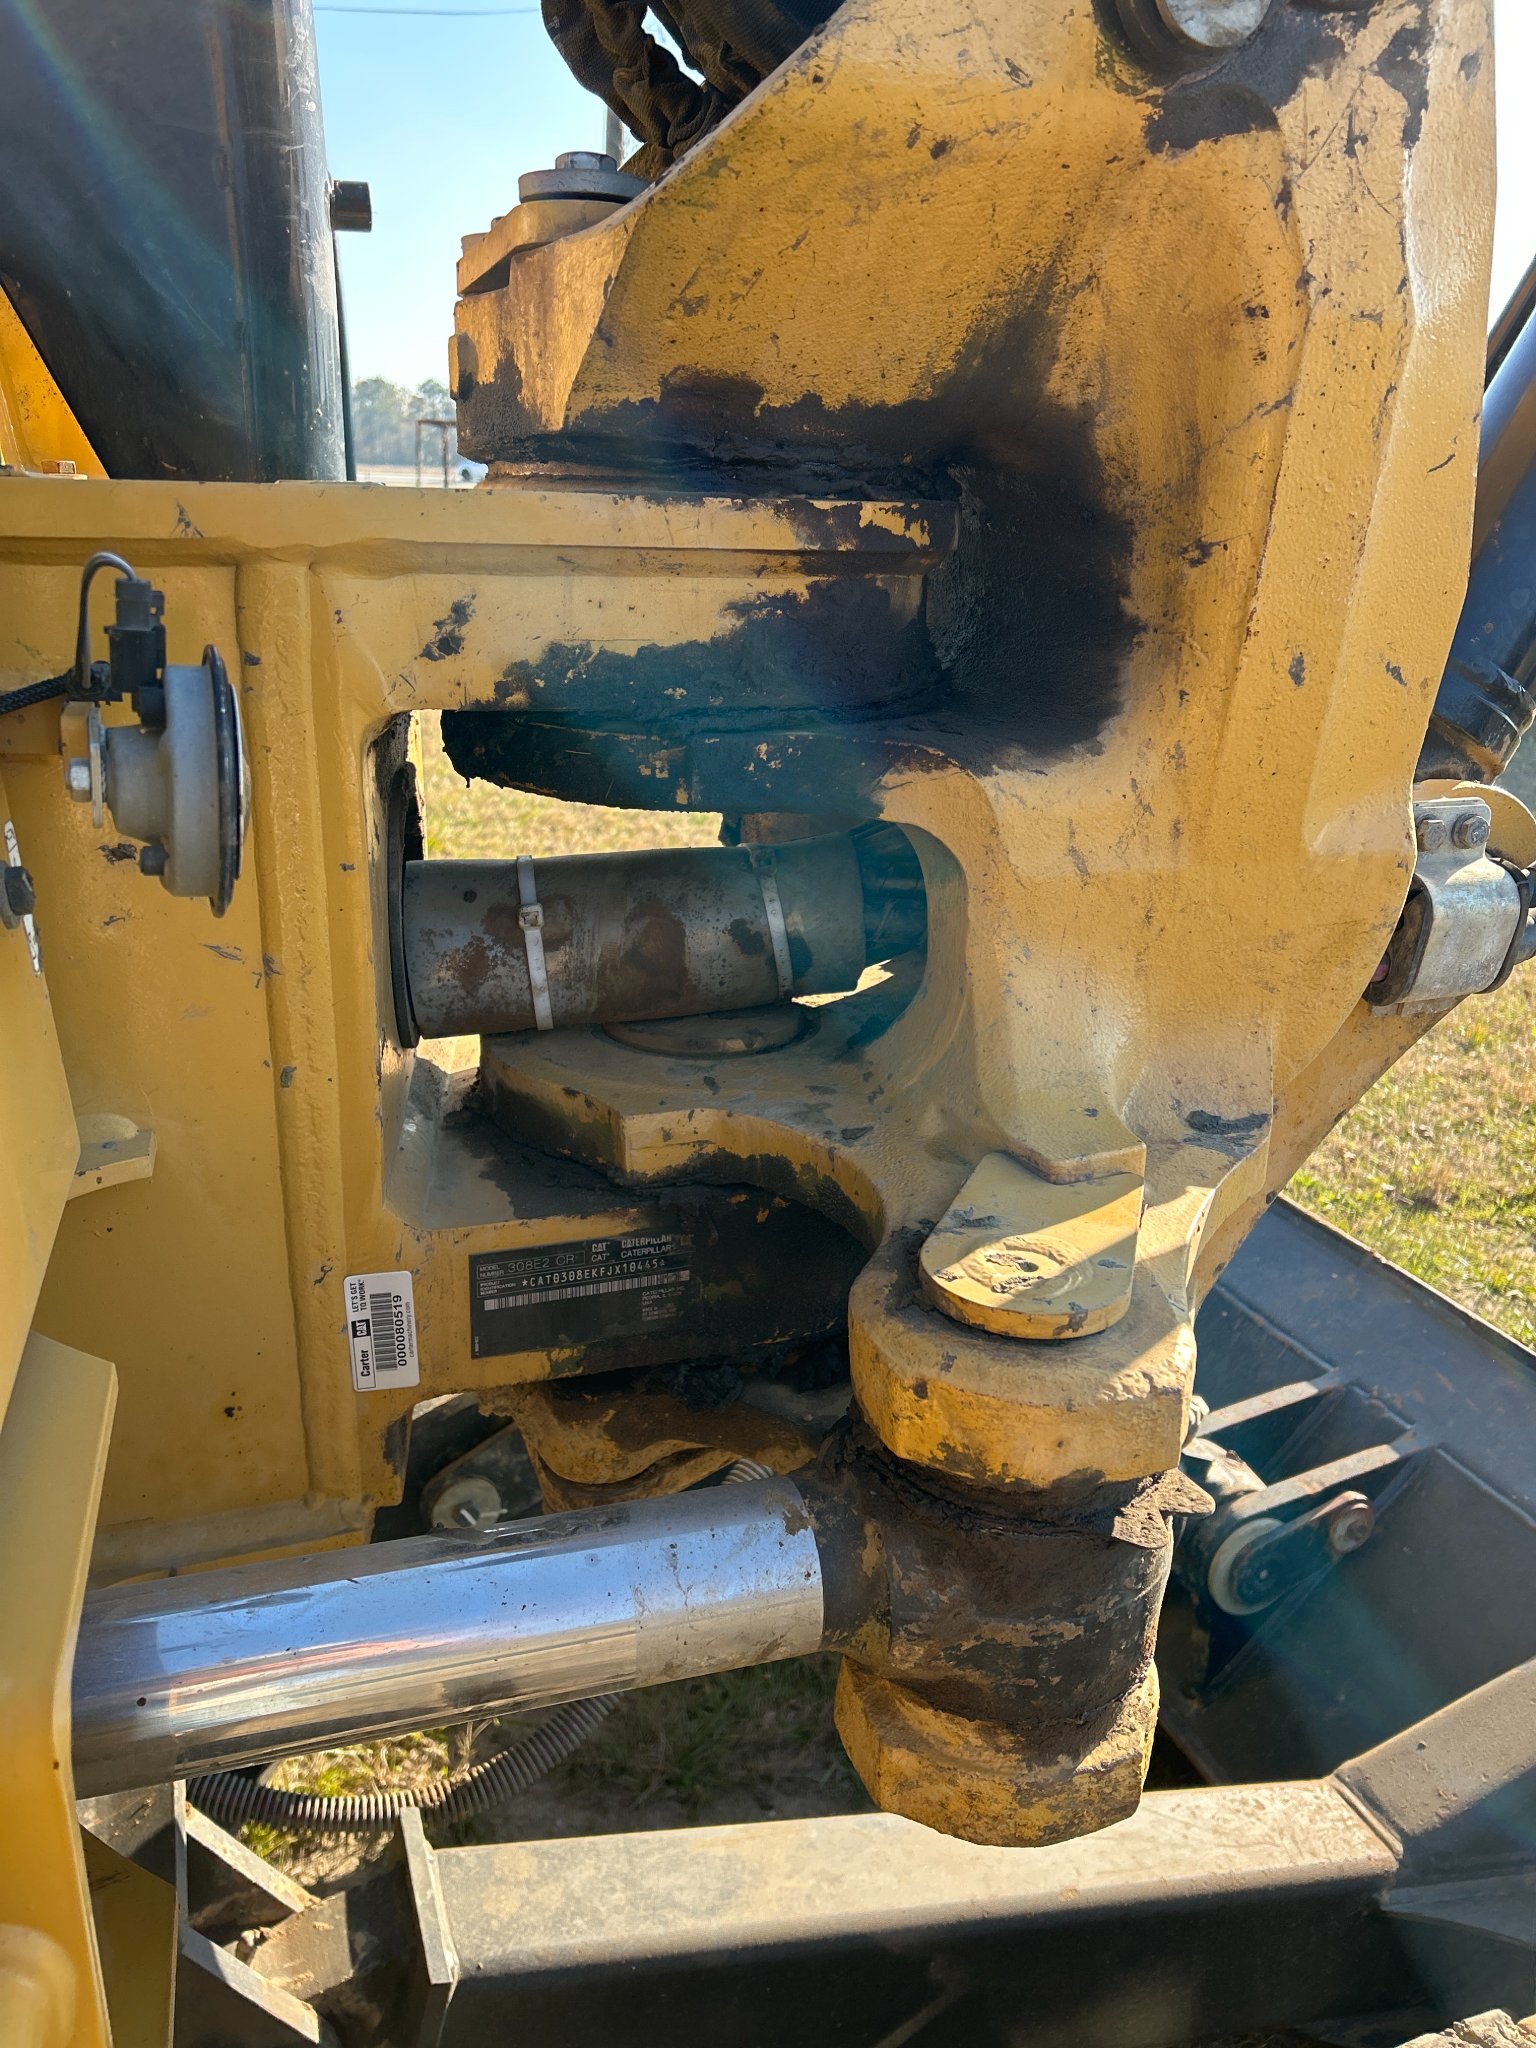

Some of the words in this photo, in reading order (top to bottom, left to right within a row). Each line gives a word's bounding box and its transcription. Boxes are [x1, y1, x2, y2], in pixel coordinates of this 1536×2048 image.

[507, 1258, 550, 1273] 308E2
[556, 1254, 575, 1266] CR
[349, 1282, 358, 1295] GET
[351, 1295, 359, 1313] LET'S
[360, 1302, 367, 1311] TO
[356, 1320, 368, 1337] CAT
[393, 1294, 407, 1367] 000080519
[405, 1301, 414, 1358] cartermachinery.com
[360, 1349, 371, 1377] Carter
